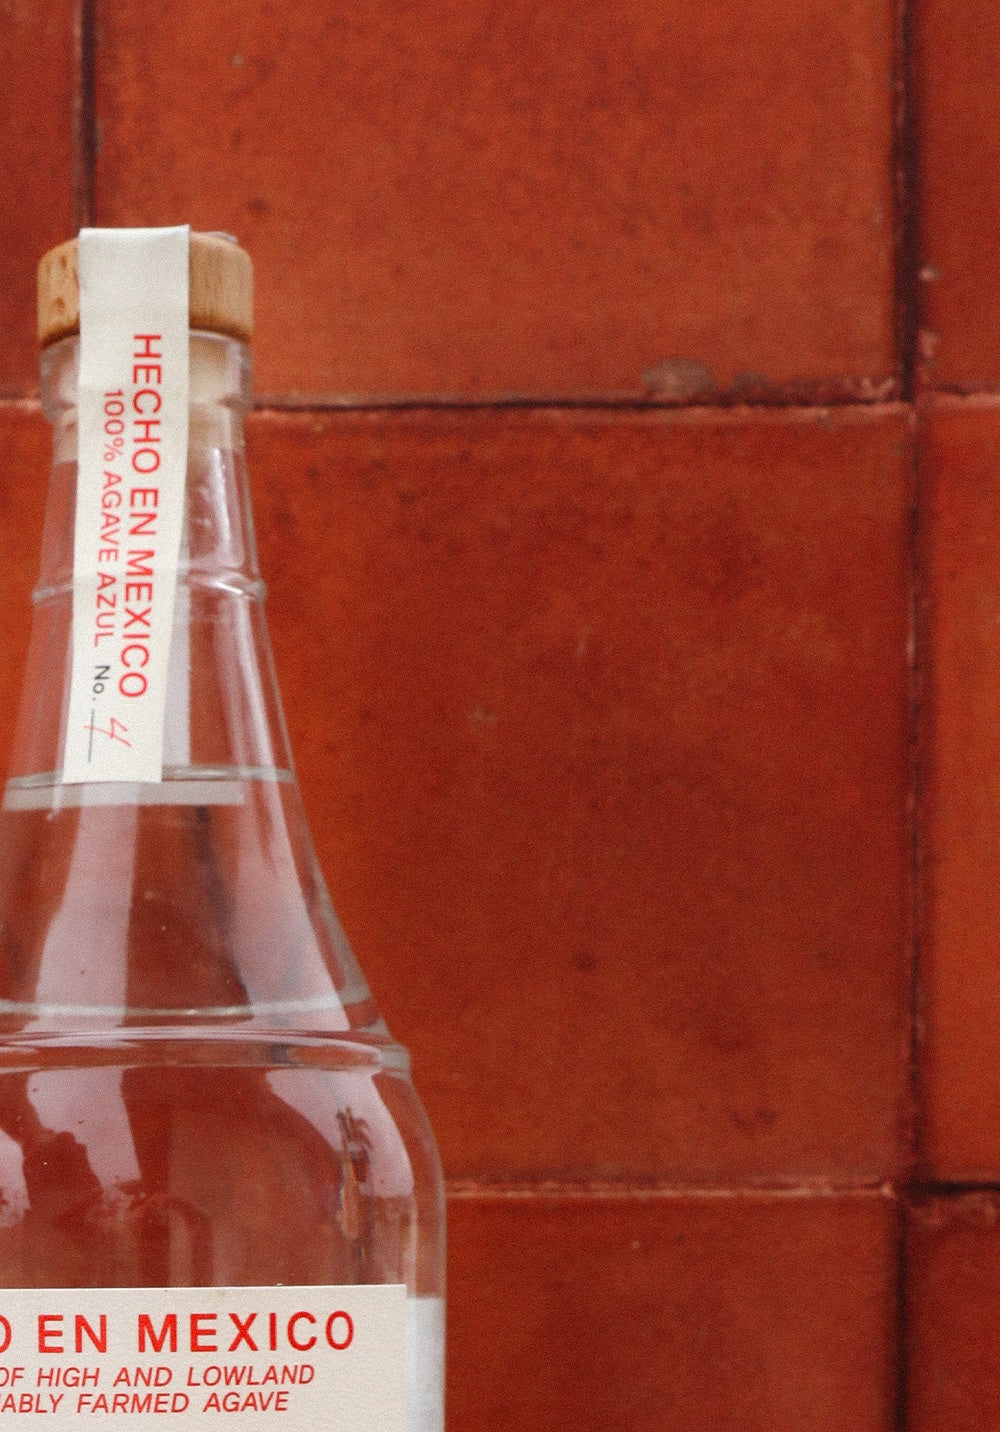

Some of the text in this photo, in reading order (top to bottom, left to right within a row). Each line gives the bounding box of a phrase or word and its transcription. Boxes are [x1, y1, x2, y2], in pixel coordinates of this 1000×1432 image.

[94, 390, 125, 648] 100% AGAVE AZUL
[118, 333, 163, 698] HECHO EN MEXICO
[92, 665, 111, 701] No.
[38, 1314, 107, 1354] EN
[138, 1310, 354, 1353] MEXICO
[36, 1367, 100, 1388] HIGH
[113, 1366, 173, 1388] AND
[187, 1364, 315, 1387] LOWLAND
[77, 1392, 189, 1414] FARMED
[203, 1391, 289, 1412] AGAVE
